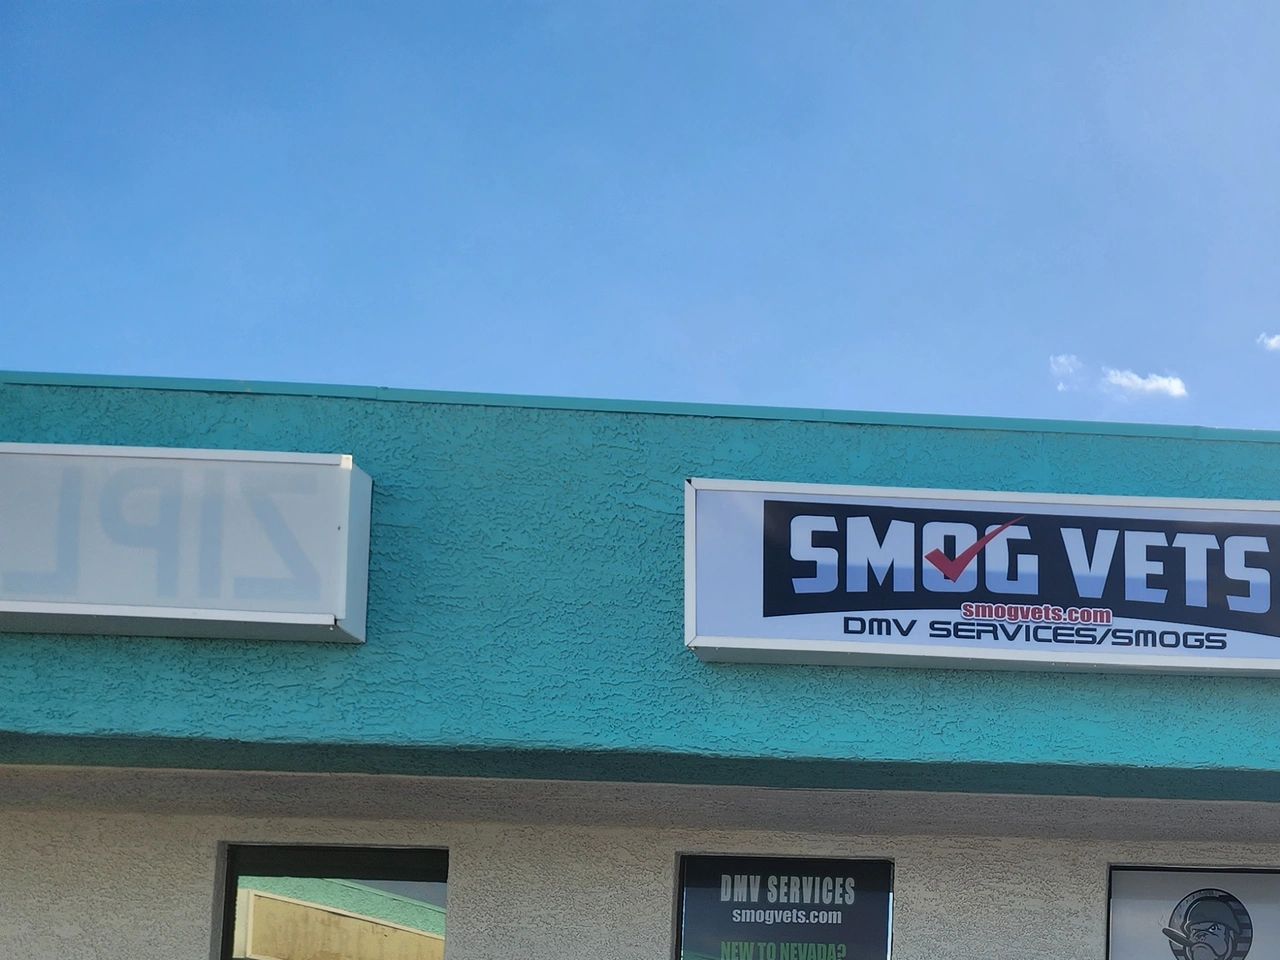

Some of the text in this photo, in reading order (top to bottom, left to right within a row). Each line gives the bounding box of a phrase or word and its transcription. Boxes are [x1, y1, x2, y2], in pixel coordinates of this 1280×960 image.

[789, 514, 1273, 614] SMOG VETS
[960, 602, 1113, 626] smogvets.com
[843, 616, 1228, 650] DMV SERVICES/SMOGS
[720, 875, 856, 905] DMV SERVICES
[732, 908, 842, 925] smogvets.com
